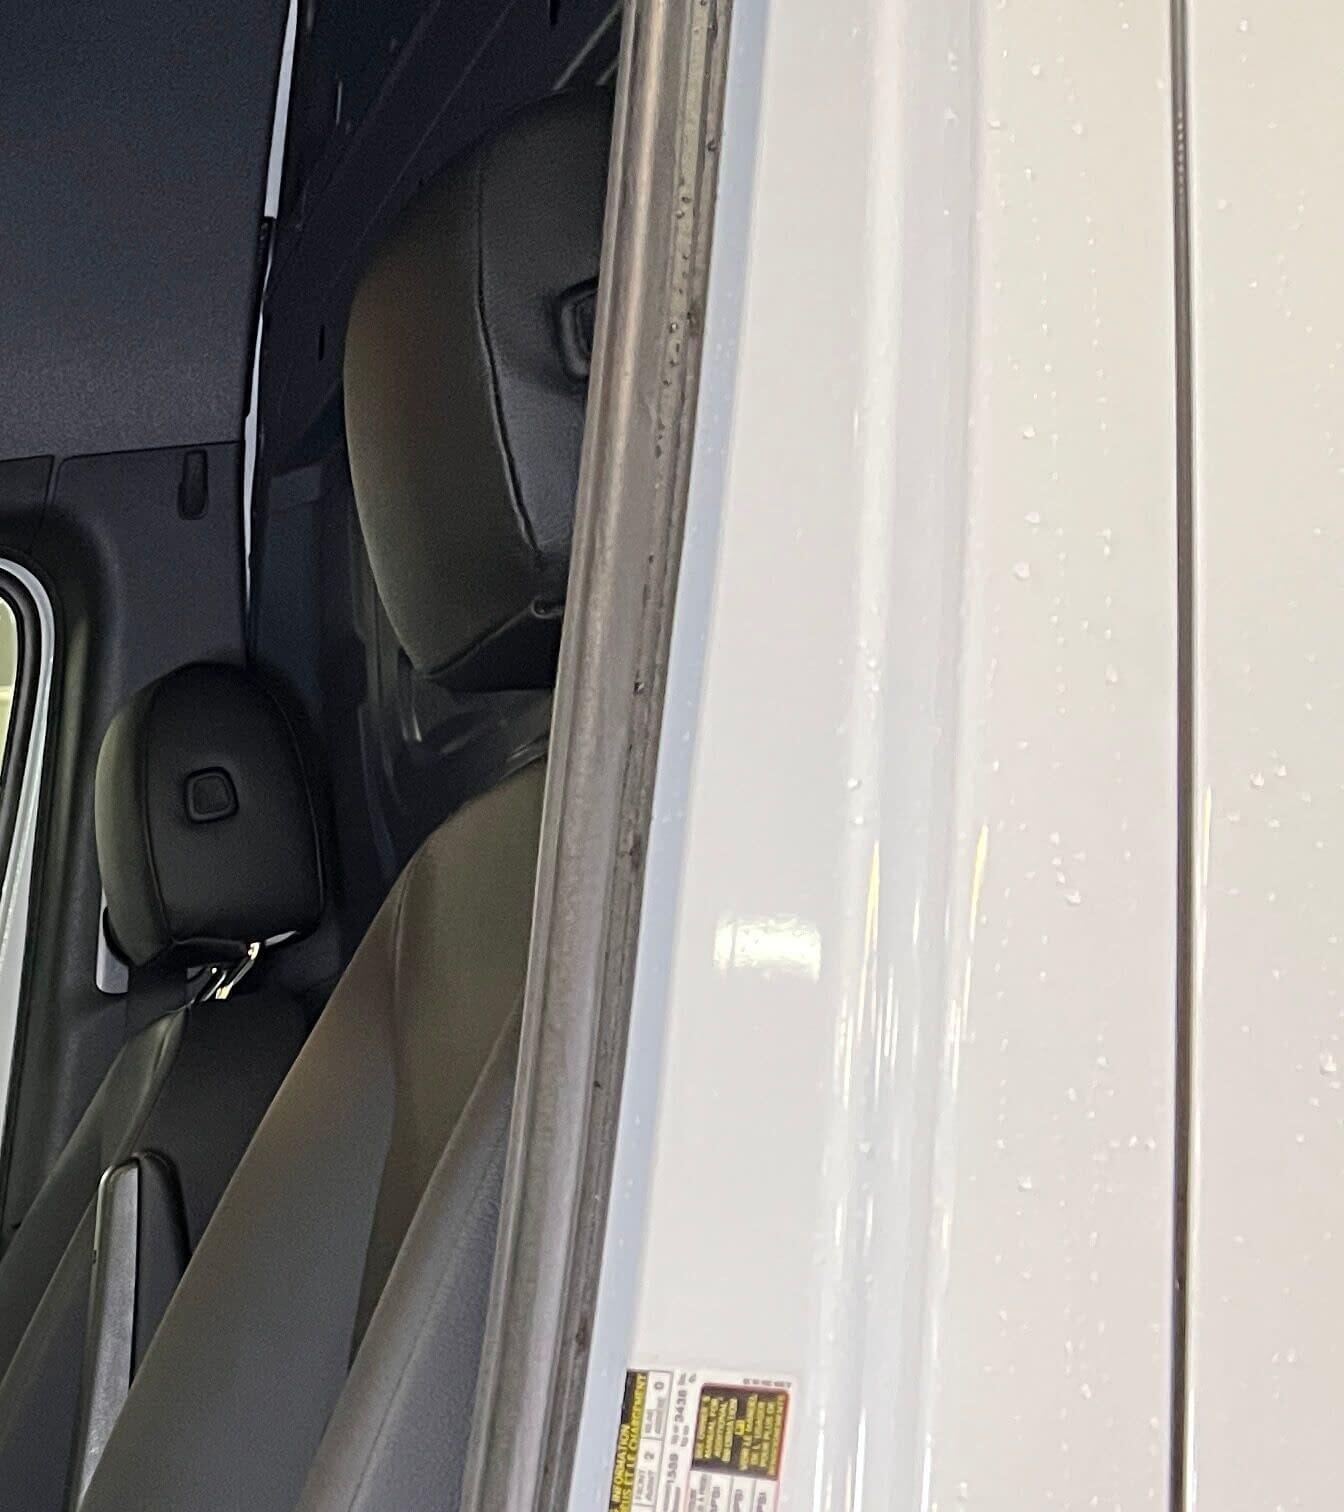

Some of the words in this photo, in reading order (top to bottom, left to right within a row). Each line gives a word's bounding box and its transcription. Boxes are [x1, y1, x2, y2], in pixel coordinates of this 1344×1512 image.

[653, 1381, 664, 1390] 0
[627, 1374, 647, 1450] CHARGEMENT
[611, 1423, 630, 1502] INFORMATION
[644, 1452, 654, 1460] 2
